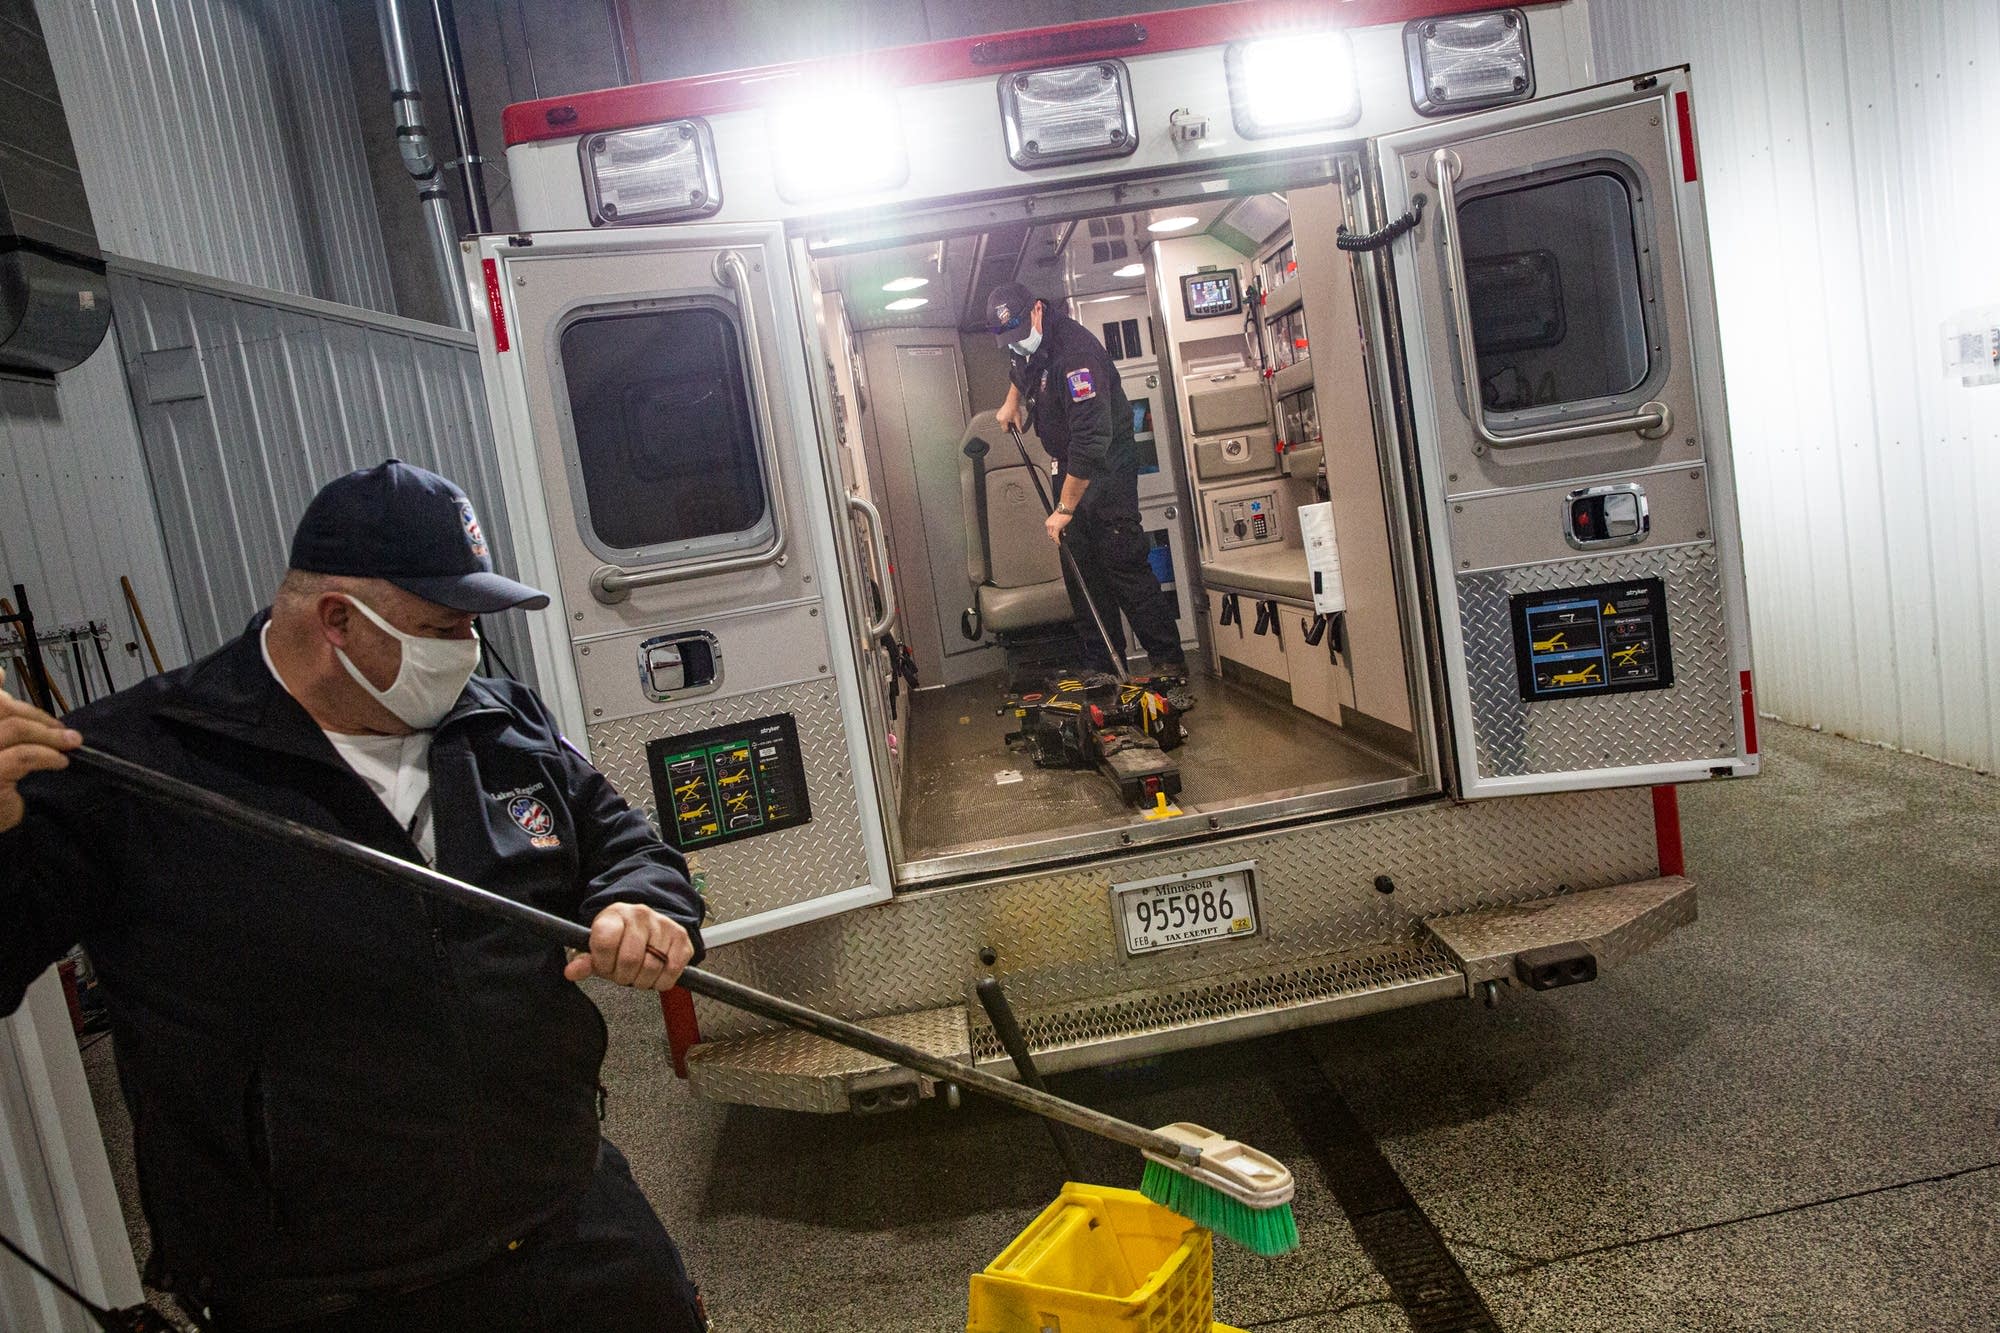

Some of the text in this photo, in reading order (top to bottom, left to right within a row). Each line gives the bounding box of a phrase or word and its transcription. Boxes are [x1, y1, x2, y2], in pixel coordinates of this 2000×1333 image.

[1626, 588, 1648, 596] stryker
[760, 725, 781, 734] stryker
[491, 782, 544, 801] Lakes Region
[1155, 880, 1213, 897] Minnesota
[1136, 888, 1234, 933] 955986
[1134, 936, 1149, 947] FEB
[1165, 926, 1219, 942] TAX EXEMPT
